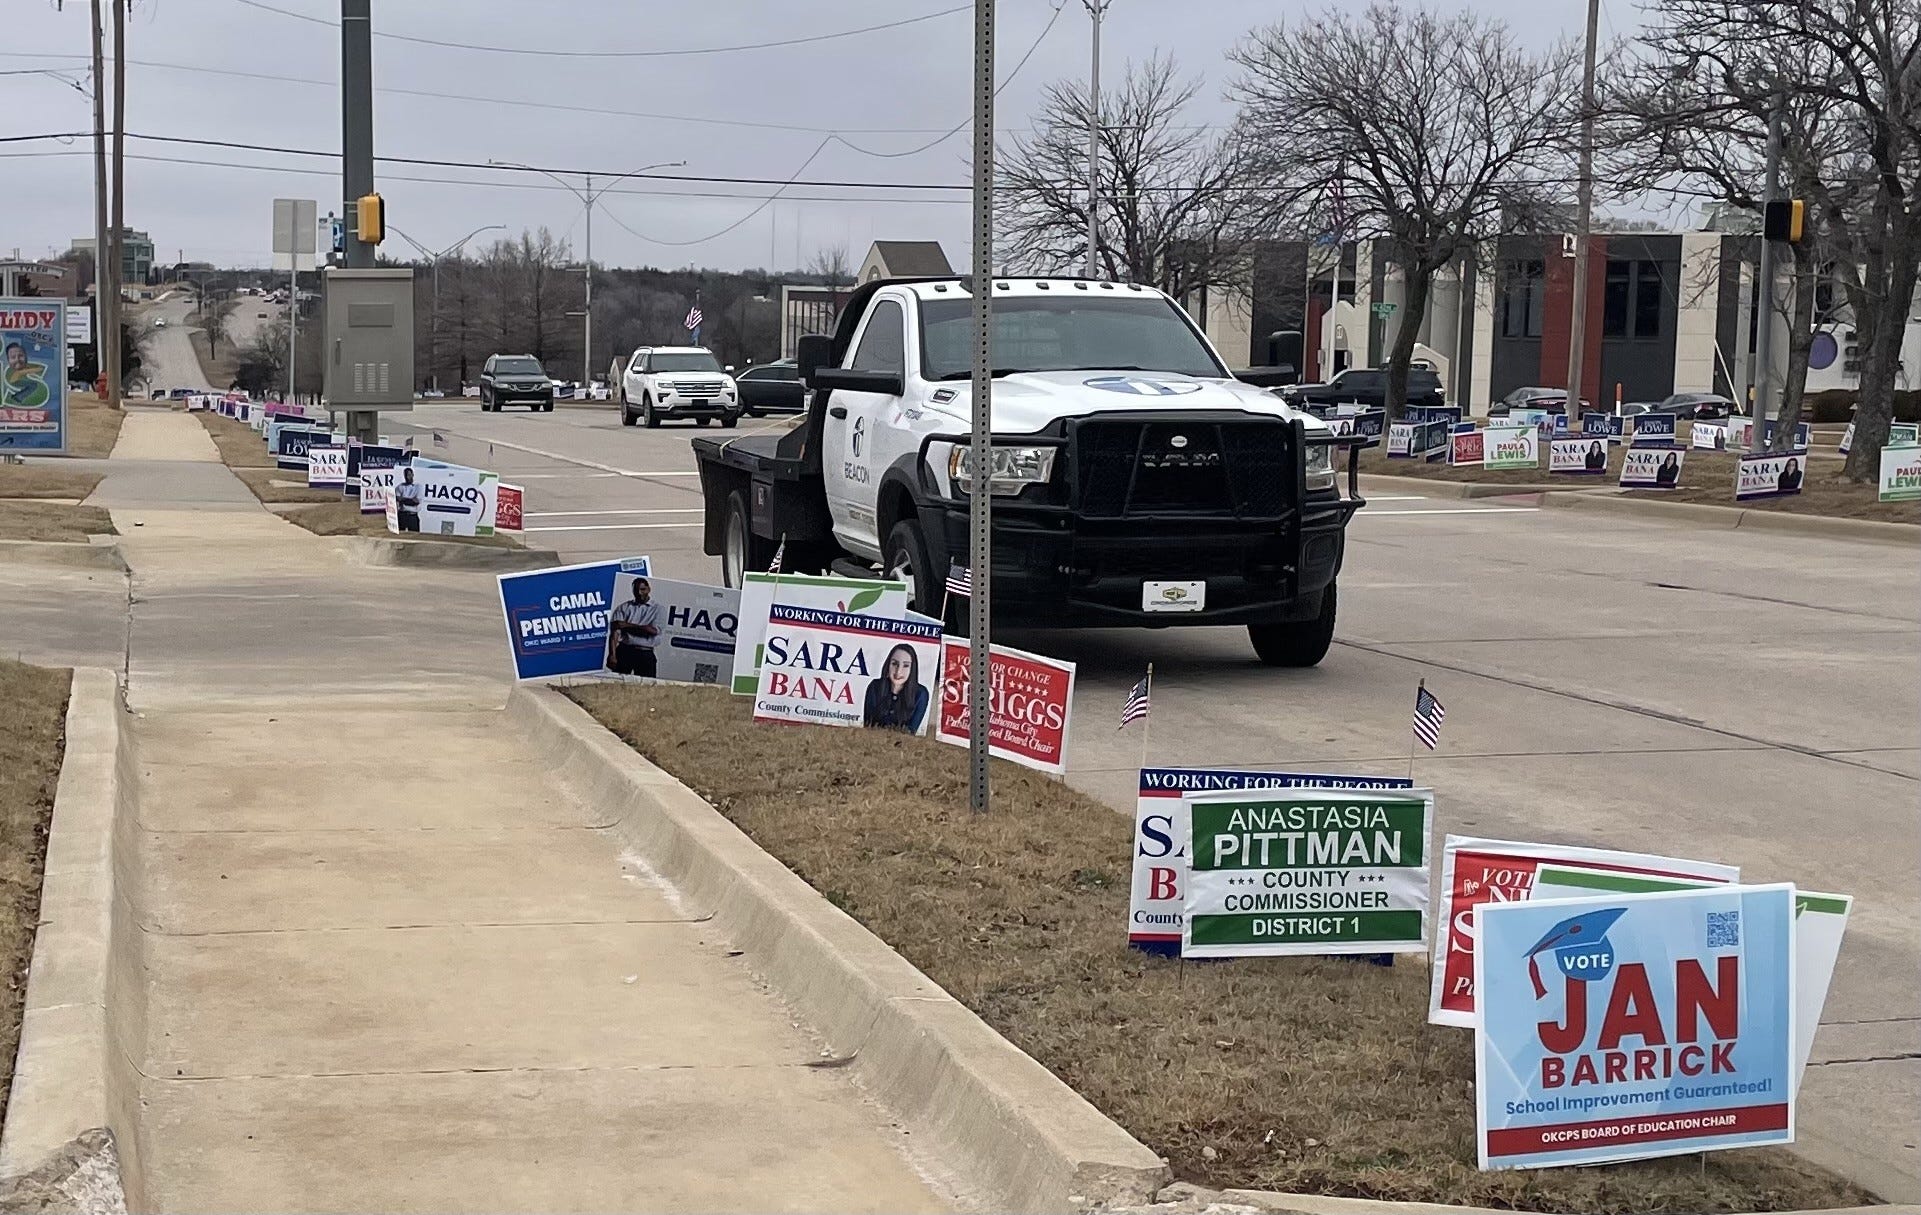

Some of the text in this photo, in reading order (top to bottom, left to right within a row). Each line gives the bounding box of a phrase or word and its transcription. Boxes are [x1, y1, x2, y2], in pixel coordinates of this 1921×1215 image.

[1588, 423, 1618, 435] LOWE
[1490, 450, 1526, 460] LEWIS
[1497, 443, 1525, 451] PAULA
[1551, 444, 1586, 455] SARA
[310, 453, 347, 465] SARA
[1553, 455, 1582, 464] BANA
[1626, 453, 1661, 465] SARA
[1626, 464, 1655, 474] BANA
[1741, 462, 1780, 475] SARA
[312, 465, 343, 475] BANA
[1741, 475, 1775, 487] BANA
[424, 483, 479, 503] HAQQ
[549, 591, 606, 612] CAMAL
[773, 606, 940, 638] WORKING FOR THE PEOPLE
[540, 637, 561, 645] WARD
[765, 636, 871, 677] SARA
[1007, 665, 1051, 685] CHANGE
[768, 671, 854, 705] BANA
[757, 700, 861, 722] County Commissioner
[1020, 721, 1039, 740] City
[1003, 729, 1029, 747] Board
[1028, 738, 1055, 754] Chair
[1145, 773, 1238, 789] WORKING
[1243, 776, 1282, 790] FOR
[1227, 806, 1390, 831] ANASTASIA
[1138, 815, 1185, 858] S
[1213, 830, 1402, 867] PITTMAN
[1147, 867, 1184, 900] B
[1263, 871, 1351, 888] COUNTY
[1224, 892, 1390, 912] COMMISSIONER
[1134, 910, 1184, 927] County
[1252, 916, 1360, 936] DISTRICT 1
[1563, 953, 1610, 970] VOTE
[1537, 956, 1739, 1054] JAN
[1541, 1041, 1737, 1089] BARRICK
[1506, 1078, 1773, 1115] School Improvement Guaranteed!
[1541, 1114, 1737, 1143] OKCPS BOARD OF EDUCATION CHAIR
